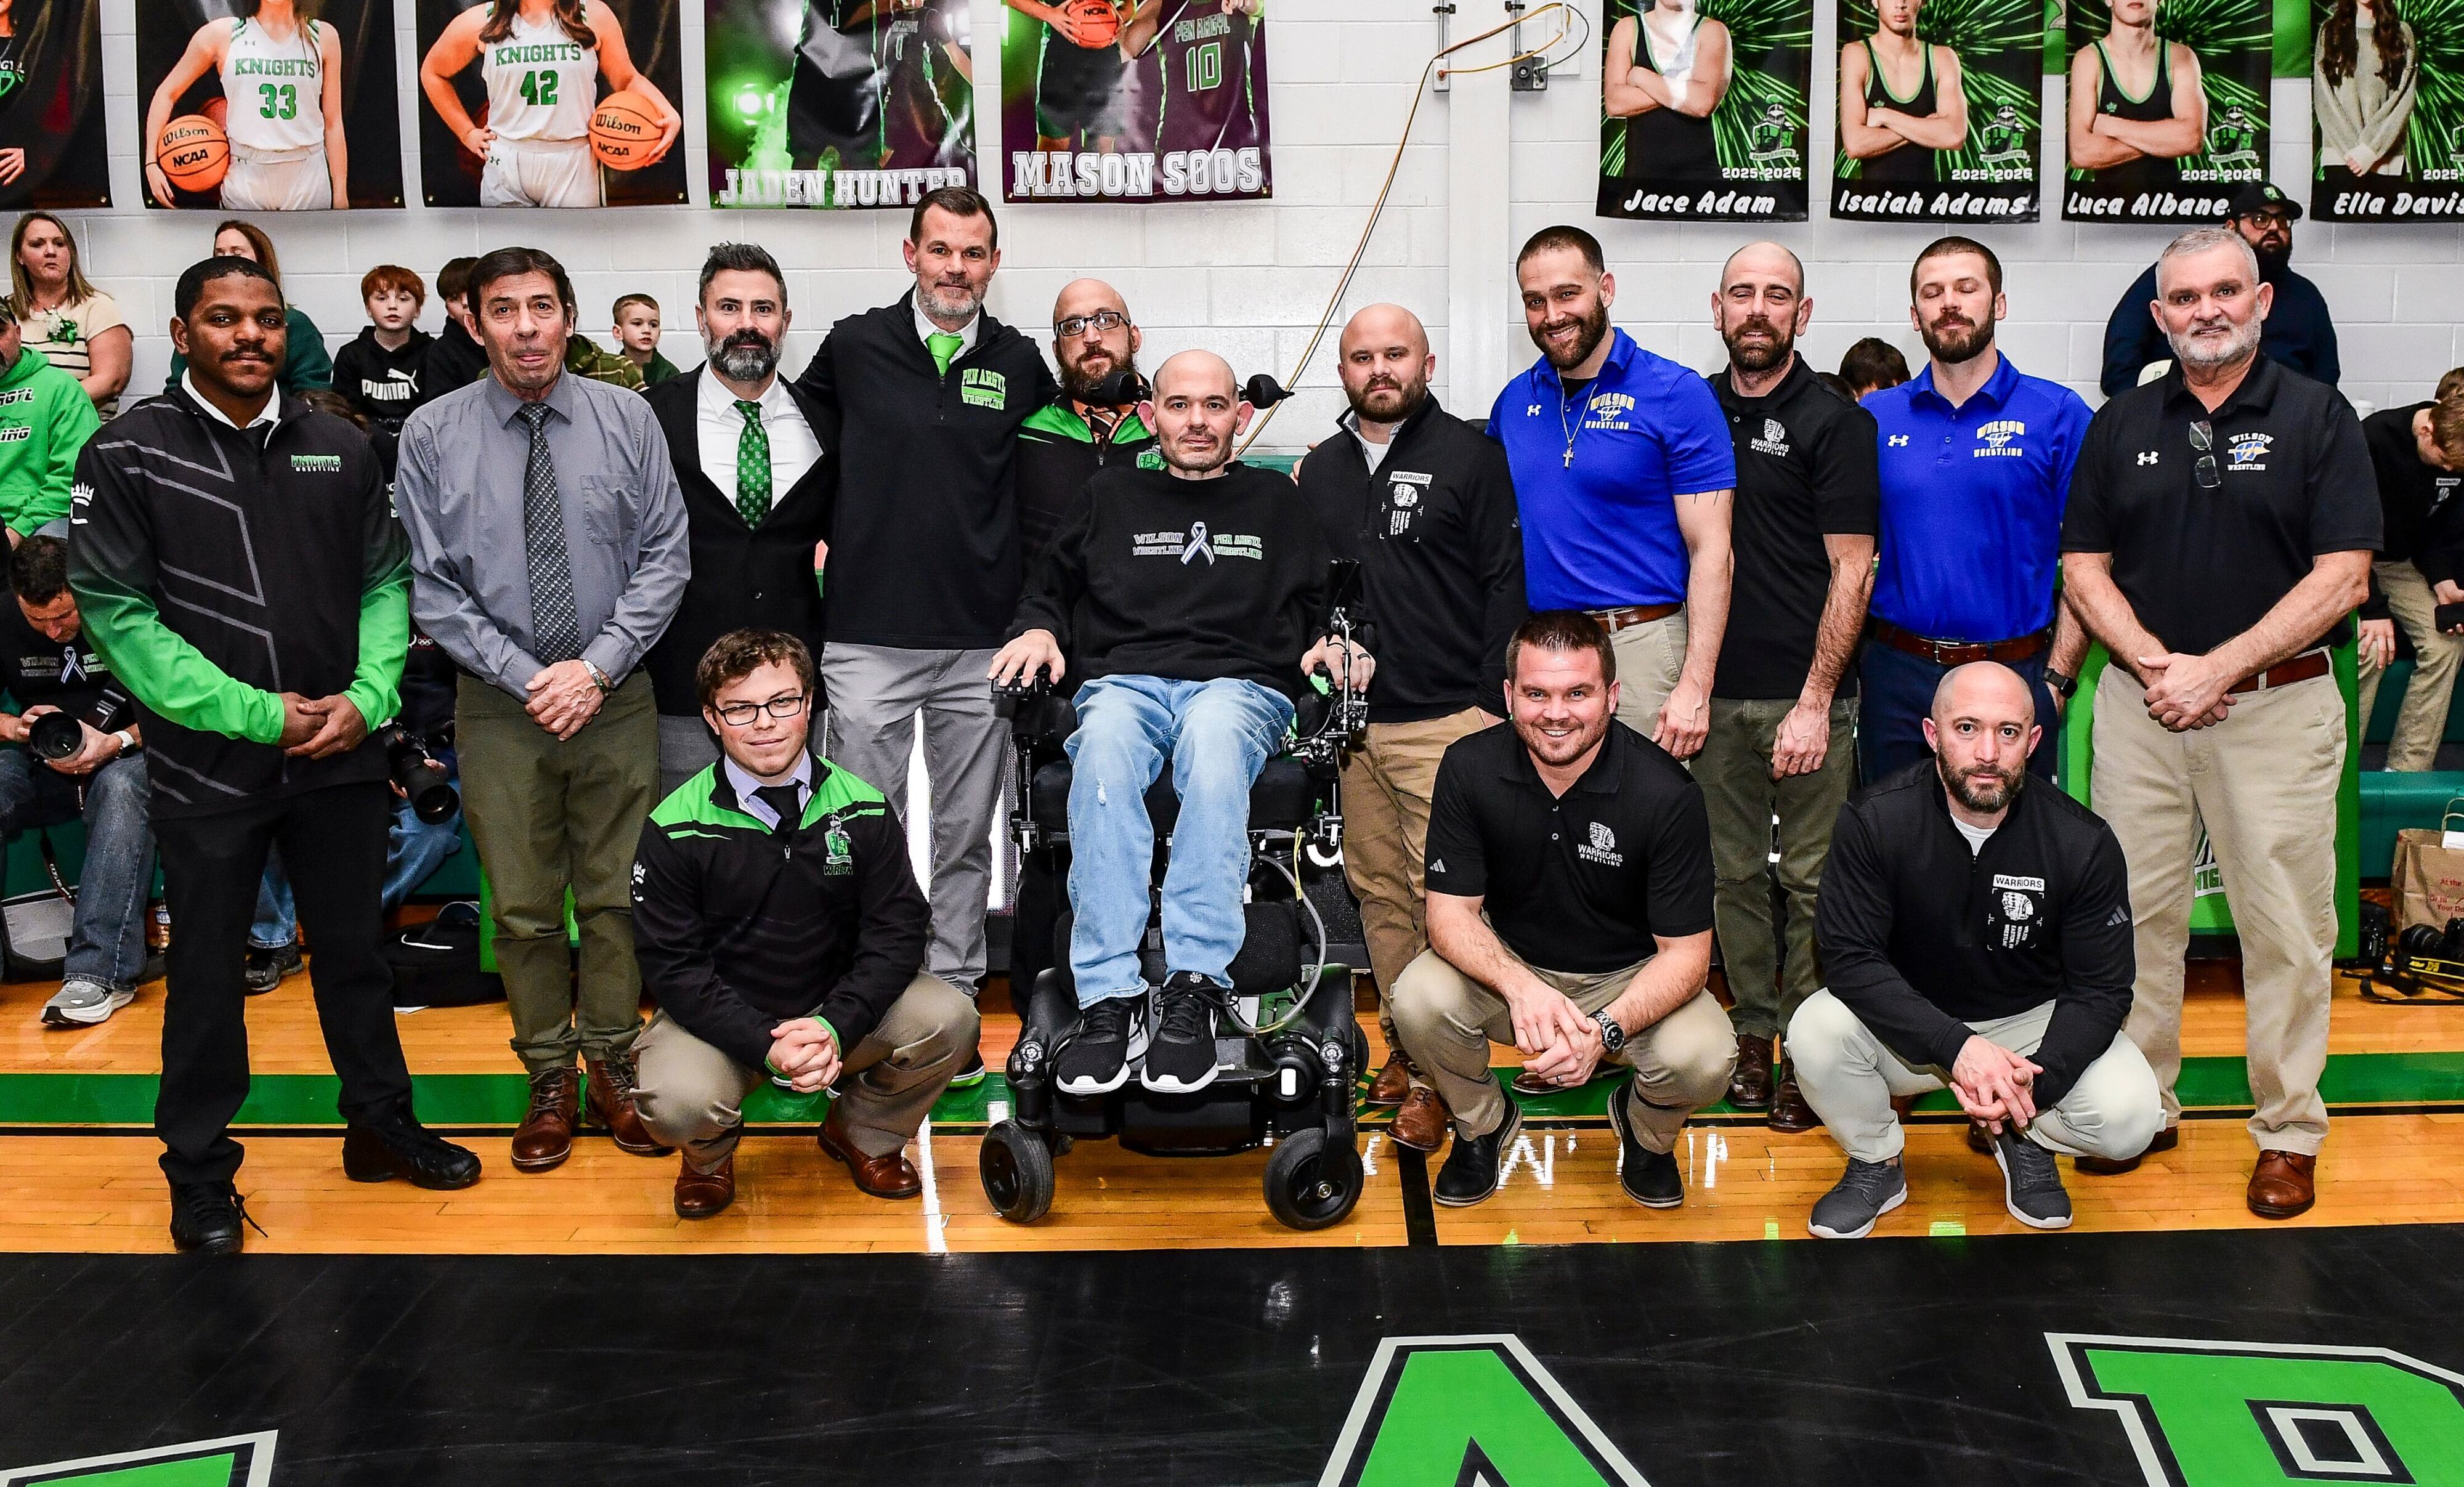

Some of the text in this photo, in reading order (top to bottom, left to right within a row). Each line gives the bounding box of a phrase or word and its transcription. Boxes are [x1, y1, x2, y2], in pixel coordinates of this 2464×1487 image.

[1174, 12, 1231, 43] PEN ARGYL
[495, 43, 581, 67] KNIGHTS
[235, 58, 316, 79] KNIGHTS
[1186, 41, 1222, 92] 10
[519, 70, 559, 106] 42
[259, 83, 297, 120] 33
[595, 113, 641, 135] Wilson
[163, 128, 209, 147] Wilson
[172, 148, 209, 168] NCAA
[597, 142, 630, 156] NCAA
[1012, 147, 1262, 197] MASON SOOS
[1722, 166, 1802, 179] 2025-2026
[1951, 168, 2033, 180] 2025-2026
[2181, 168, 2262, 181] 2025-2026
[719, 168, 827, 206] JADEN
[1623, 188, 1776, 214] Jace Adam
[1838, 189, 2029, 216] Isaiah Adams
[2067, 191, 2231, 216] Luca Albane
[2333, 191, 2386, 215] Ella
[362, 379, 411, 400] PUMA
[962, 368, 1006, 394] PEN ARGYL
[962, 394, 1005, 411] WRESTLING
[1590, 392, 1635, 411] WILSON
[1976, 420, 2025, 439] WILSON
[2229, 432, 2274, 444] WILSON
[1751, 437, 1790, 453] WARRIORS
[1392, 472, 1430, 482] WARRIORS
[1133, 532, 1185, 545] WILSON
[1213, 534, 1262, 549] PEN ARGYL
[1133, 545, 1185, 556] WRESTLING
[1212, 545, 1263, 561] WRESTLING
[1578, 843, 1623, 862] WARRIORS
[1996, 876, 2042, 888] WARRIORS
